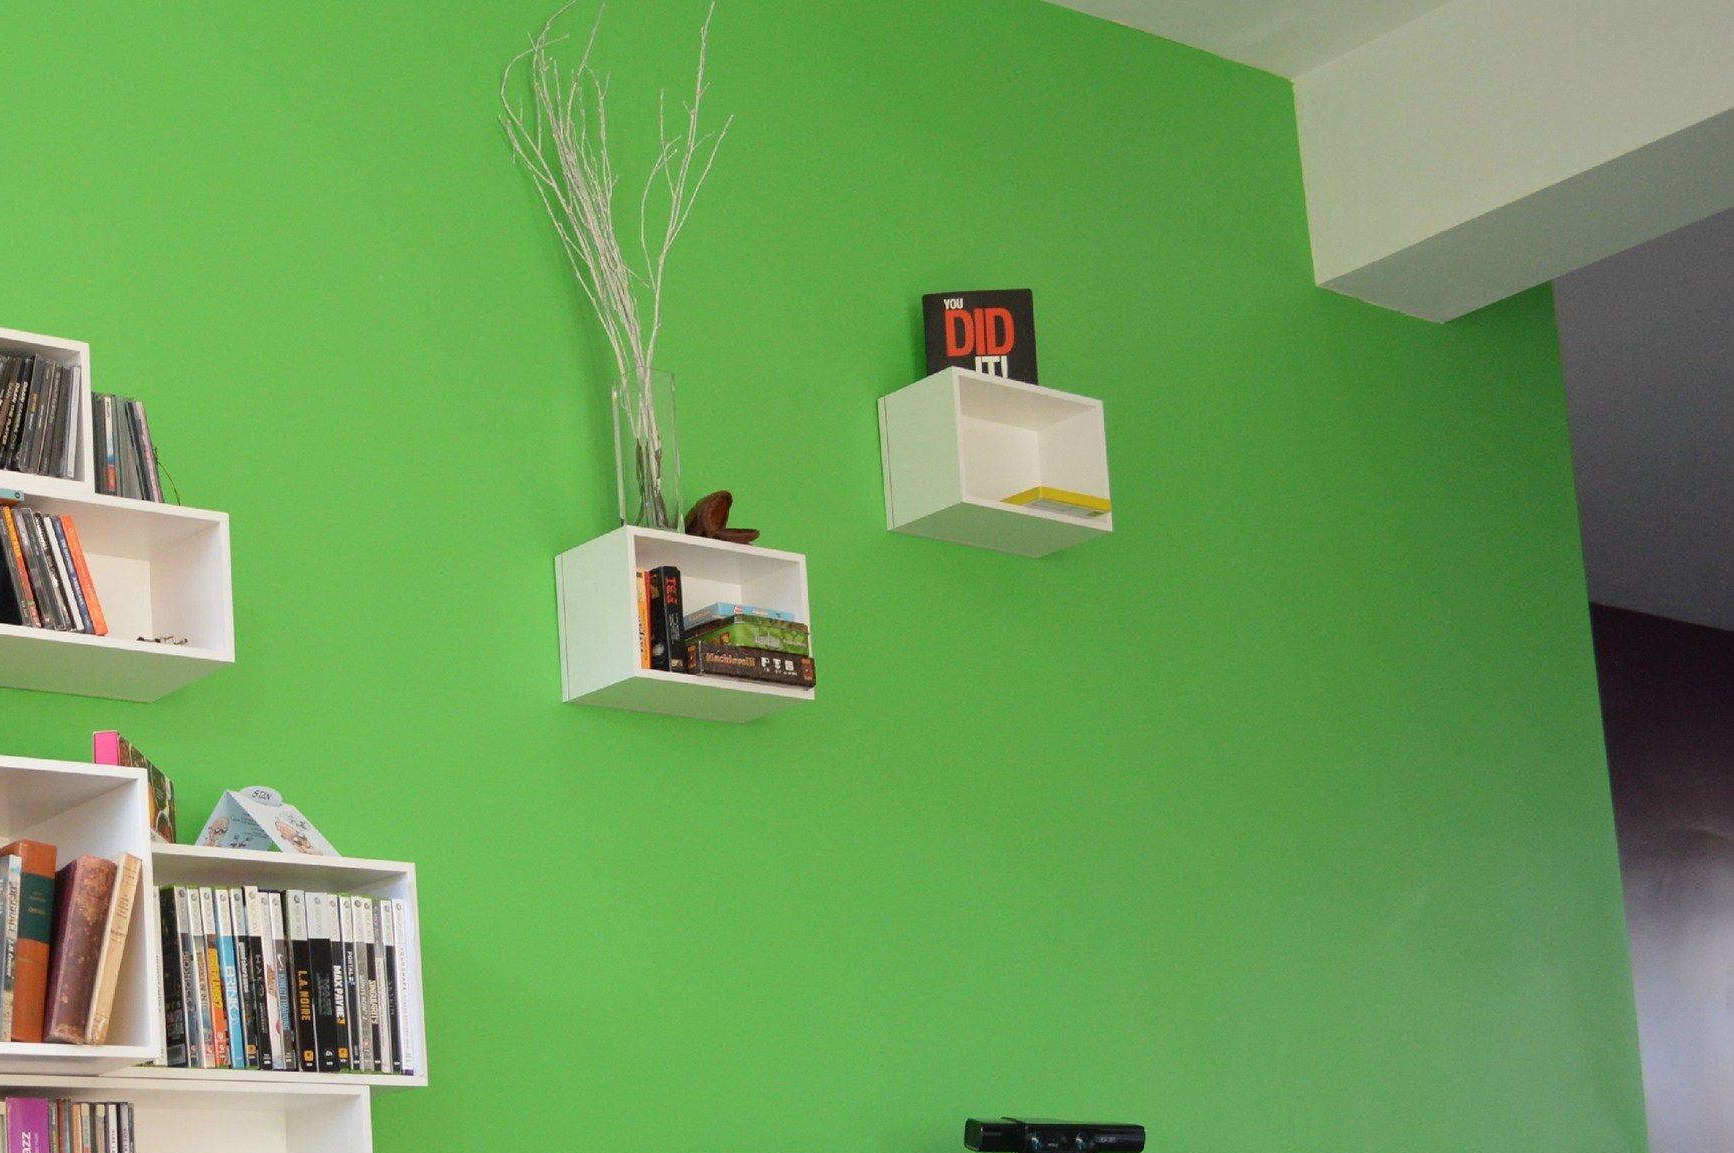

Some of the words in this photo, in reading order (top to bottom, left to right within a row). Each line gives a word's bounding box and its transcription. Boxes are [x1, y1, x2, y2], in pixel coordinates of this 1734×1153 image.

[943, 297, 964, 309] YOU
[944, 307, 1015, 357] DID
[704, 652, 756, 668] Machiavelli
[333, 965, 343, 986] MAX
[347, 951, 355, 975] PORTAL
[226, 966, 238, 1010] BRINK
[298, 971, 308, 989] L.A.
[300, 991, 311, 1021] NOIRE
[334, 988, 344, 1018] PAYNE
[368, 980, 378, 1024] SINGULARITY
